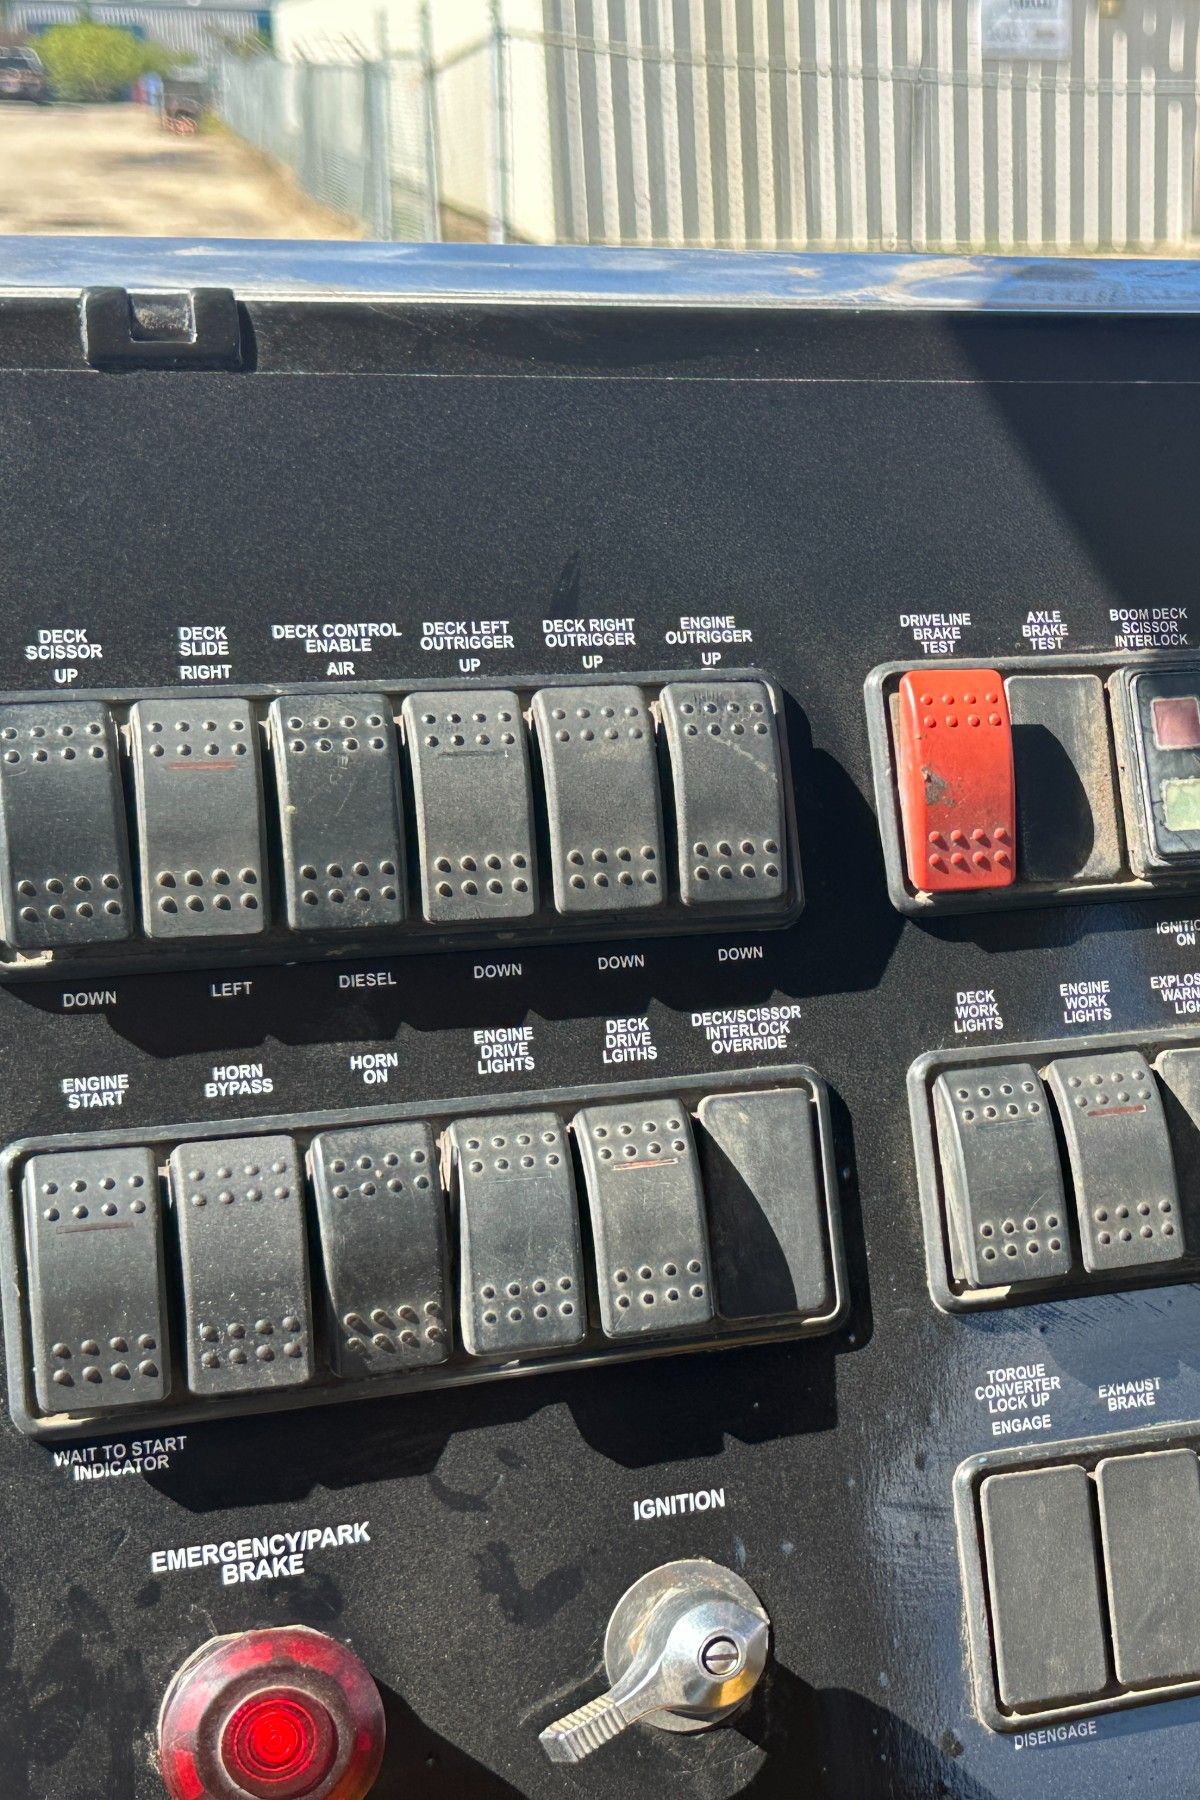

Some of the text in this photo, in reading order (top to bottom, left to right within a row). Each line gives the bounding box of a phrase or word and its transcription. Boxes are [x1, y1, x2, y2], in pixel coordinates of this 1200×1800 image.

[900, 613, 971, 628] DRIVELINE
[1026, 610, 1061, 624] AXLE
[1109, 607, 1188, 622] BOOM DECK
[271, 623, 402, 639] DECK CONTROL
[422, 620, 510, 636] DECK LEFT
[542, 618, 635, 634] DECK RIGHT
[680, 616, 736, 630] ENGINE
[1022, 623, 1069, 638] BRAKE
[1122, 620, 1179, 634] SCISSOR
[38, 629, 87, 644] DECK
[179, 626, 227, 641] DECK
[545, 632, 636, 648] OUTRIGGER
[665, 629, 753, 645] OUTRIGGER
[913, 626, 961, 641] BRAKE
[1114, 634, 1188, 648] INTERLOCK
[179, 640, 230, 656] SLIDE
[305, 638, 372, 653] ENABLE
[420, 635, 515, 651] OUTRIGGER
[921, 640, 955, 654] TEST
[1030, 637, 1064, 650] TEST
[25, 644, 103, 660] SCISSOR
[701, 652, 722, 666] UP
[327, 661, 355, 676] AIR
[459, 658, 481, 673] UP
[582, 655, 603, 669] UP
[54, 669, 78, 684] UP
[180, 665, 232, 680] RIGHT
[1176, 933, 1196, 946] ON
[598, 954, 645, 970] DOWN
[718, 946, 763, 962] DOWN
[474, 963, 522, 979] DOWN
[339, 972, 397, 989] DIESEL
[1059, 980, 1111, 997] ENGINE
[211, 981, 253, 997] LEFT
[956, 989, 996, 1004] DECK
[63, 990, 117, 1008] DOWN
[1064, 994, 1108, 1009] WORK
[691, 1005, 801, 1027] DECK/SCISSOR
[955, 1002, 1000, 1019] WORK
[1063, 1007, 1112, 1024] LIGHTS
[606, 1017, 649, 1033] DECK
[705, 1020, 790, 1040] INTERLOCK
[954, 1016, 1003, 1034] LIGHTS
[473, 1026, 534, 1045] ENGINE
[605, 1032, 652, 1049] DRIVE
[480, 1042, 529, 1059] DRIVE
[711, 1035, 788, 1054] OVERRIDE
[350, 1052, 398, 1070] HORN
[602, 1046, 657, 1064] LGITHS
[213, 1063, 264, 1081] HORN
[477, 1056, 535, 1075] LIGHTS
[62, 1074, 129, 1094] ENGINE
[363, 1068, 388, 1084] ON
[204, 1078, 273, 1098] BYPASS
[68, 1090, 126, 1110] START
[986, 1363, 1046, 1384] TORQUE
[974, 1376, 1061, 1401] CONVERTER
[1098, 1376, 1162, 1399] EXHAUST
[988, 1392, 1051, 1414] LOCK UP
[1107, 1392, 1155, 1412] BRAKE
[991, 1414, 1052, 1436] ENGAGE
[53, 1435, 188, 1467] WAIT TO START
[73, 1454, 170, 1482] INDICATOR
[633, 1488, 726, 1521] IGNITION
[151, 1521, 371, 1573] EMERGENCY/PARK
[222, 1553, 305, 1586] BRAKE
[1014, 1721, 1097, 1749] DISENGAGE
